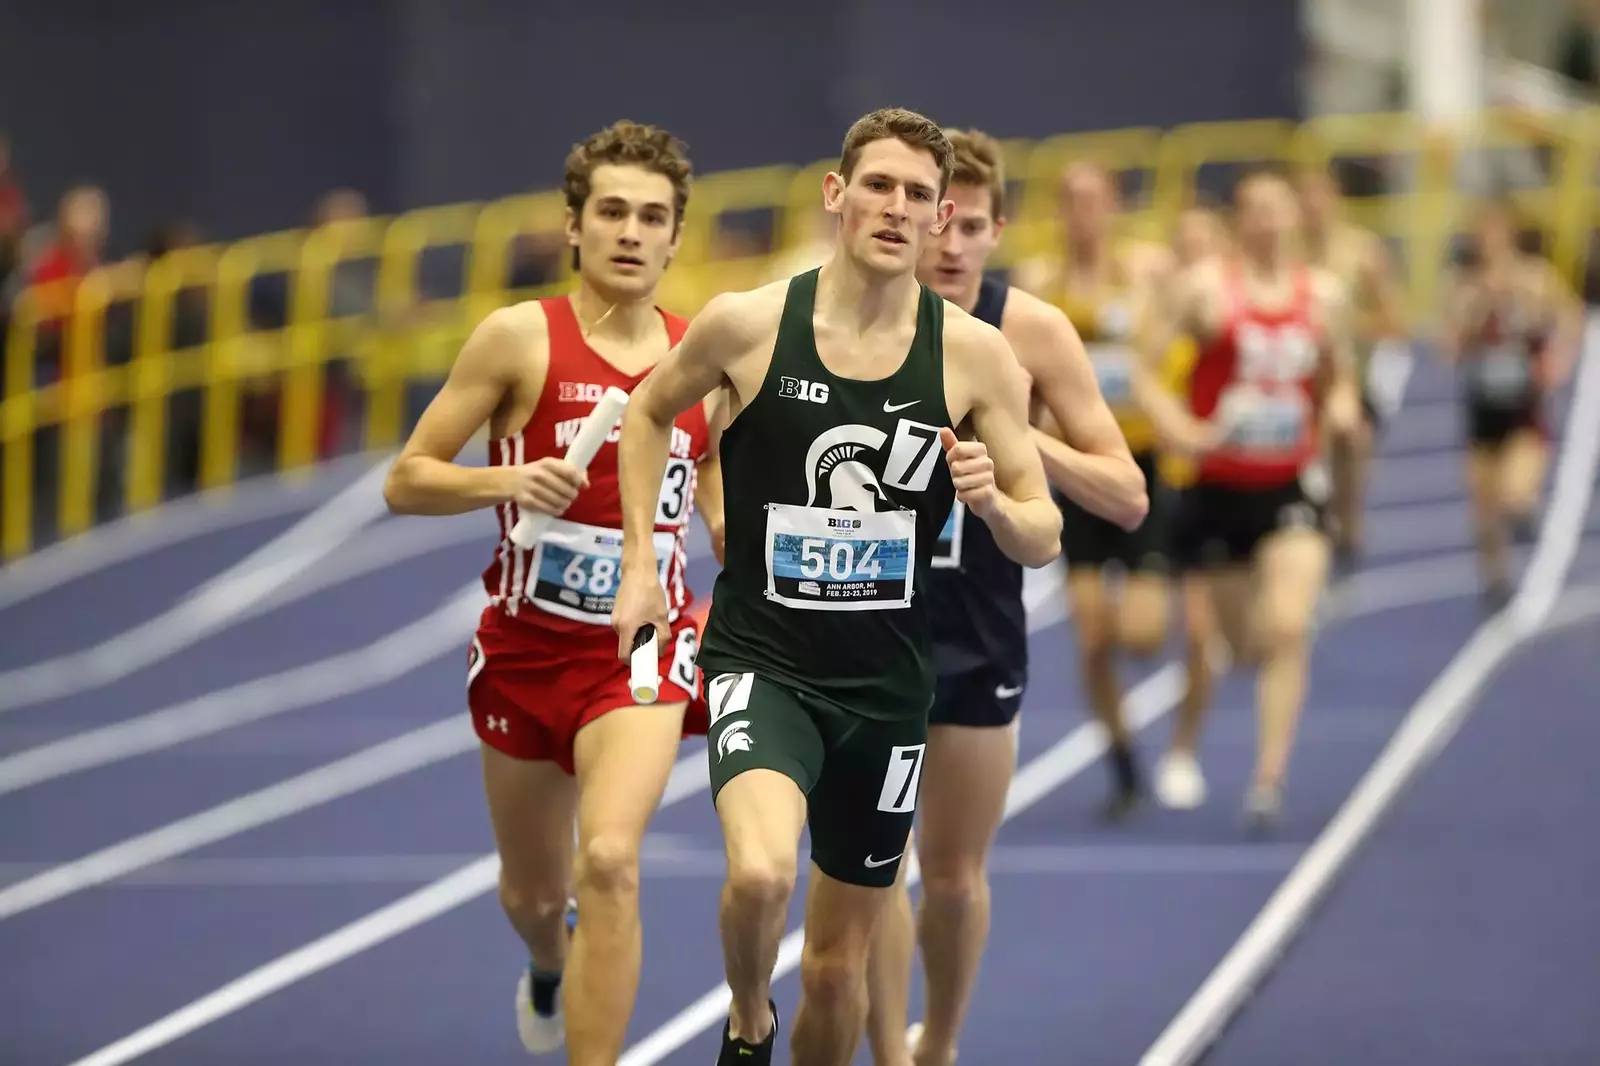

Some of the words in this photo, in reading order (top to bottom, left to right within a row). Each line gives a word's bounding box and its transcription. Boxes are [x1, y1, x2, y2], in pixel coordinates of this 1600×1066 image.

[897, 425, 939, 486] 7
[661, 464, 687, 519] 3
[562, 554, 623, 595] 68
[800, 538, 882, 580] 504
[716, 672, 744, 718] 7
[892, 749, 920, 808] 7
